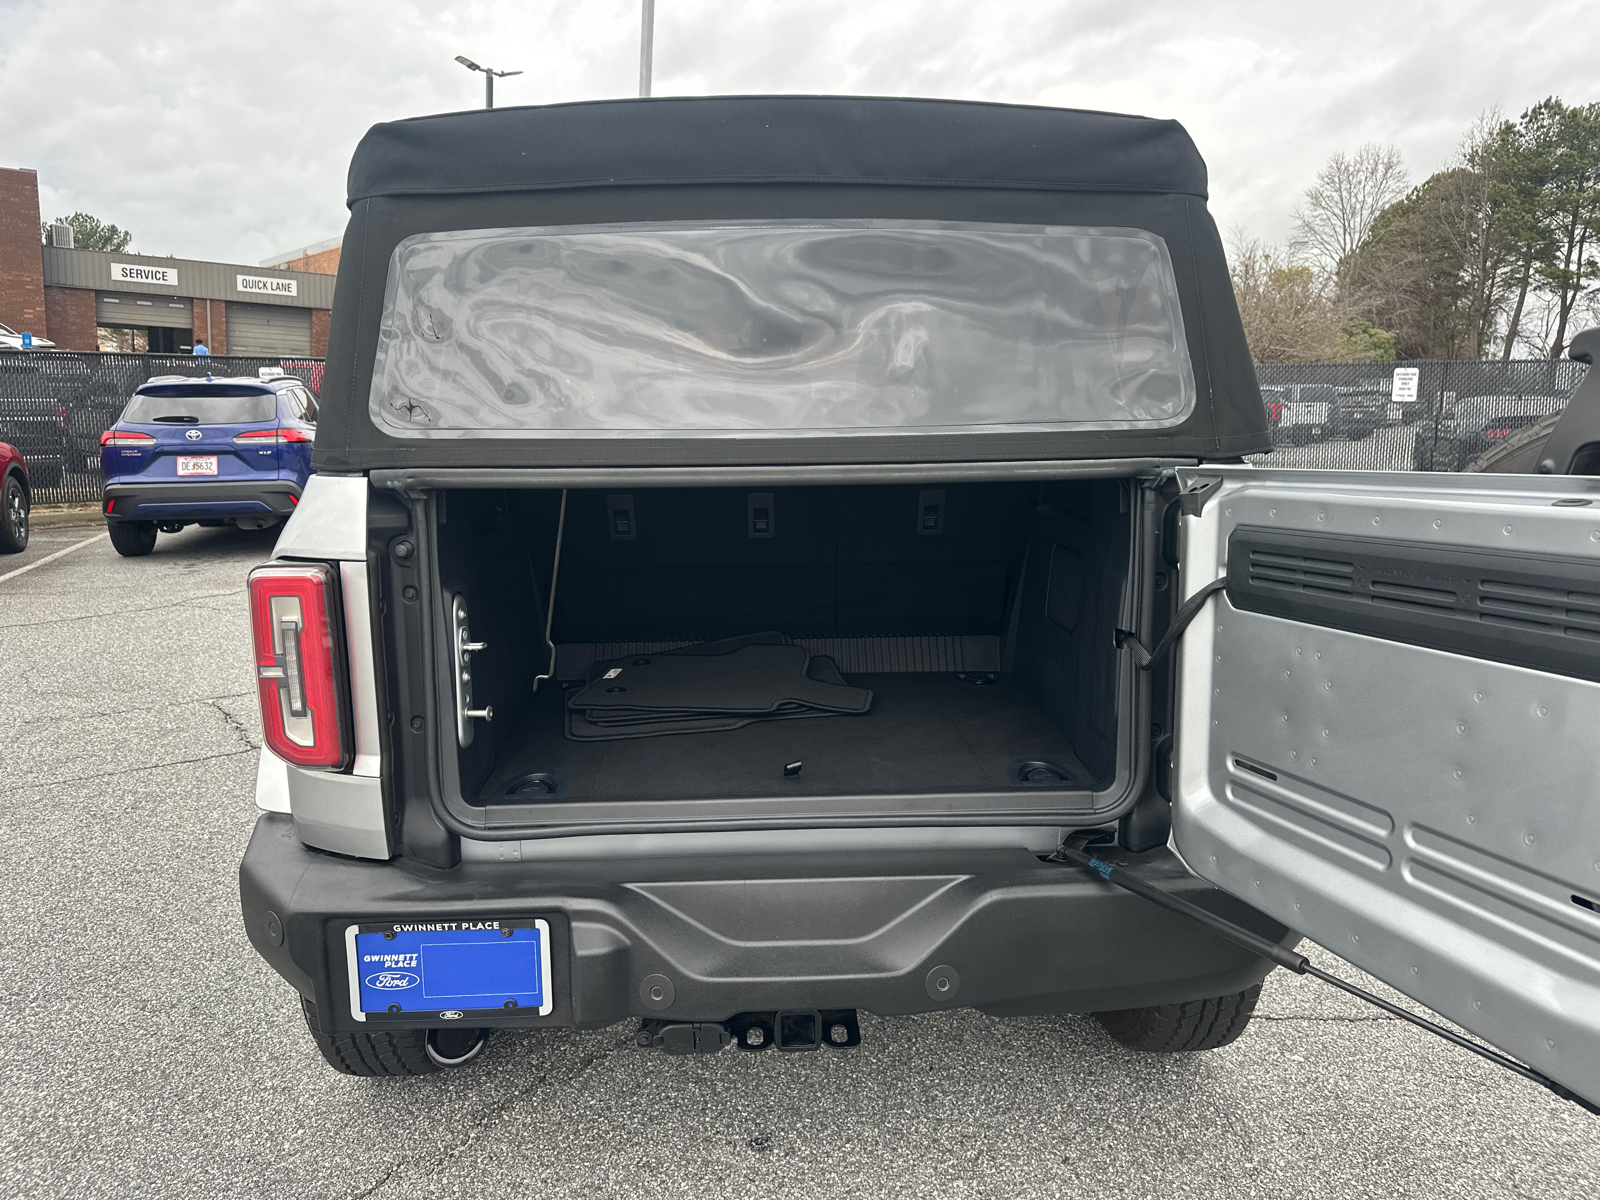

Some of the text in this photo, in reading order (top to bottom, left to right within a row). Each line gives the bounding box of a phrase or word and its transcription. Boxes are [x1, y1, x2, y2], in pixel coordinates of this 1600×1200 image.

[121, 267, 169, 282] SERVICE
[241, 278, 293, 293] QUICK LANE
[393, 921, 500, 932] GWINNETT PLACE
[363, 953, 419, 963] GWINNETT
[384, 960, 418, 968] PLACE
[375, 973, 410, 988] Ford
